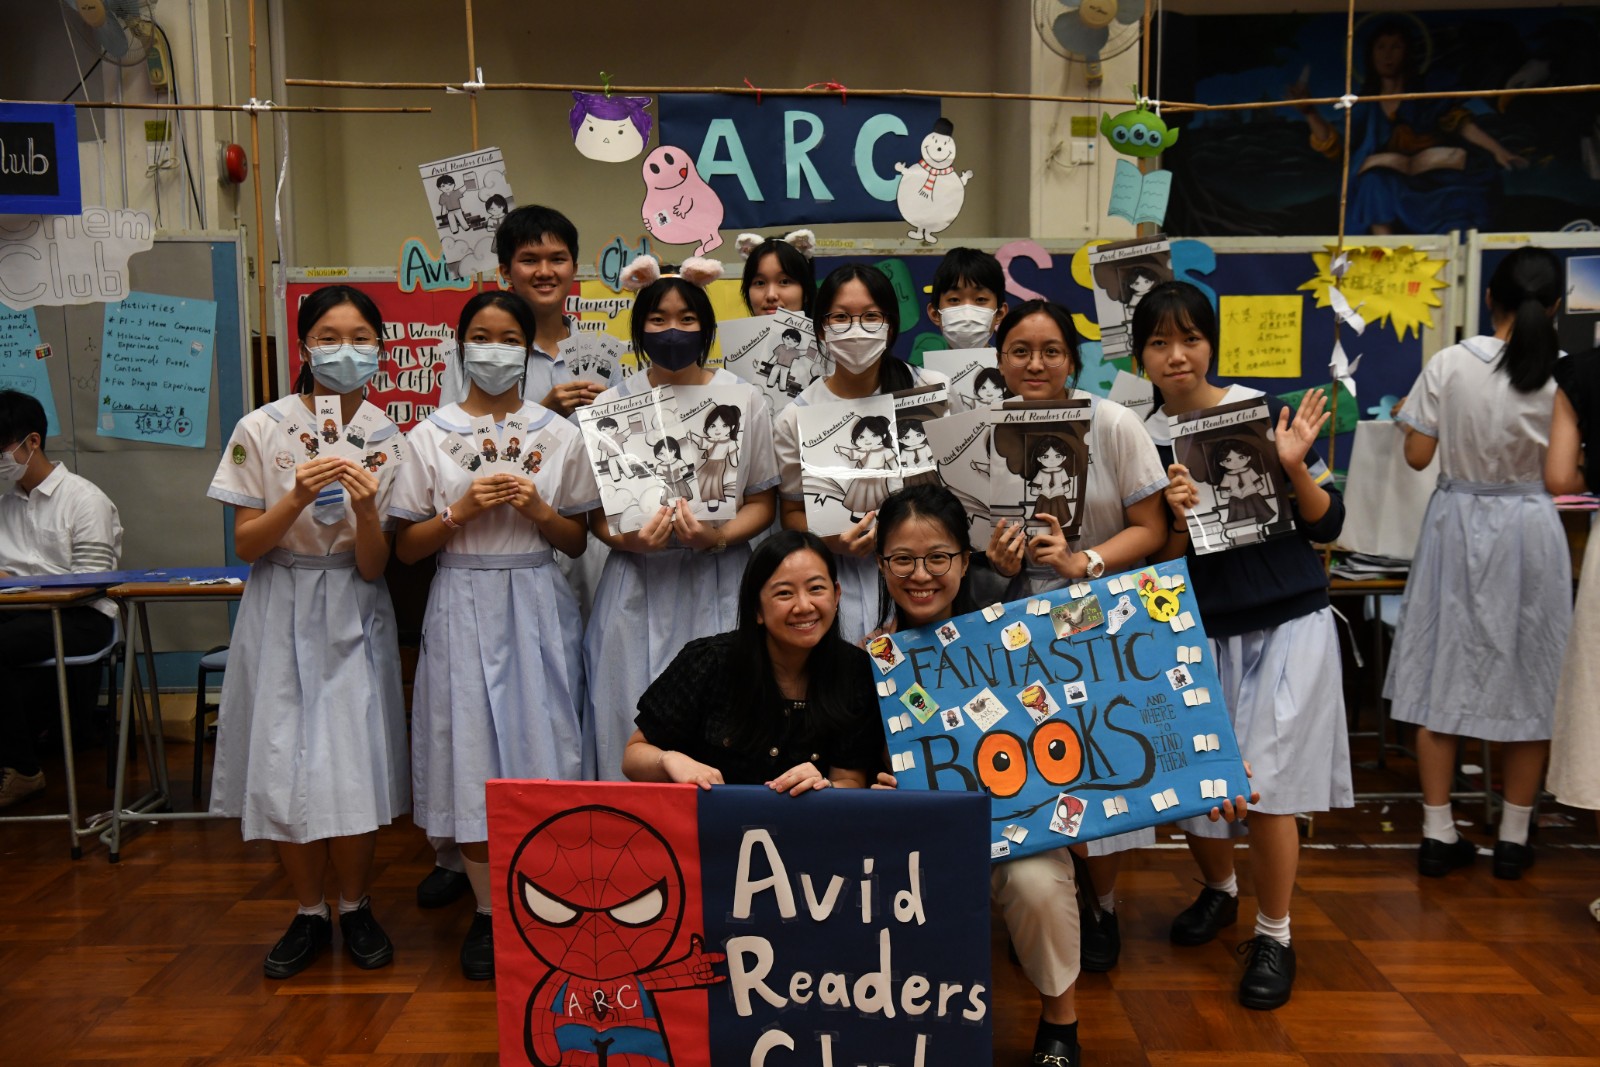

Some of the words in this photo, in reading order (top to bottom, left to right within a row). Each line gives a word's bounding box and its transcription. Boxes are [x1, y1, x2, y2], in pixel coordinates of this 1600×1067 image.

[476, 153, 494, 166] Club
[695, 110, 909, 202] ARC
[0, 241, 123, 303] Club
[406, 246, 465, 286] Avi
[120, 299, 175, 314] Activities
[566, 297, 632, 319] Manager
[117, 331, 151, 342] Molecular
[117, 341, 160, 351] Experiment
[131, 378, 158, 392] Dragon
[162, 380, 206, 394] Experiment
[612, 398, 643, 413] Readers
[1003, 410, 1027, 423] Avid
[1029, 410, 1060, 421] Readers
[1062, 409, 1081, 420] Club
[478, 426, 491, 435] ARC
[506, 420, 523, 431] ARC
[1180, 418, 1200, 436] Avid
[1202, 414, 1234, 430] Readers
[1236, 408, 1258, 421] Club
[903, 630, 1161, 689] FANTASTIC
[1146, 693, 1168, 707] AND
[1139, 704, 1177, 725] WHERE
[1156, 722, 1172, 735] TO
[1151, 733, 1184, 754] FIND
[910, 694, 1156, 819] BOOKS
[1156, 751, 1189, 773] THEM
[731, 828, 927, 927] Avid
[725, 927, 987, 1022] Readers
[567, 983, 639, 1018] ARC
